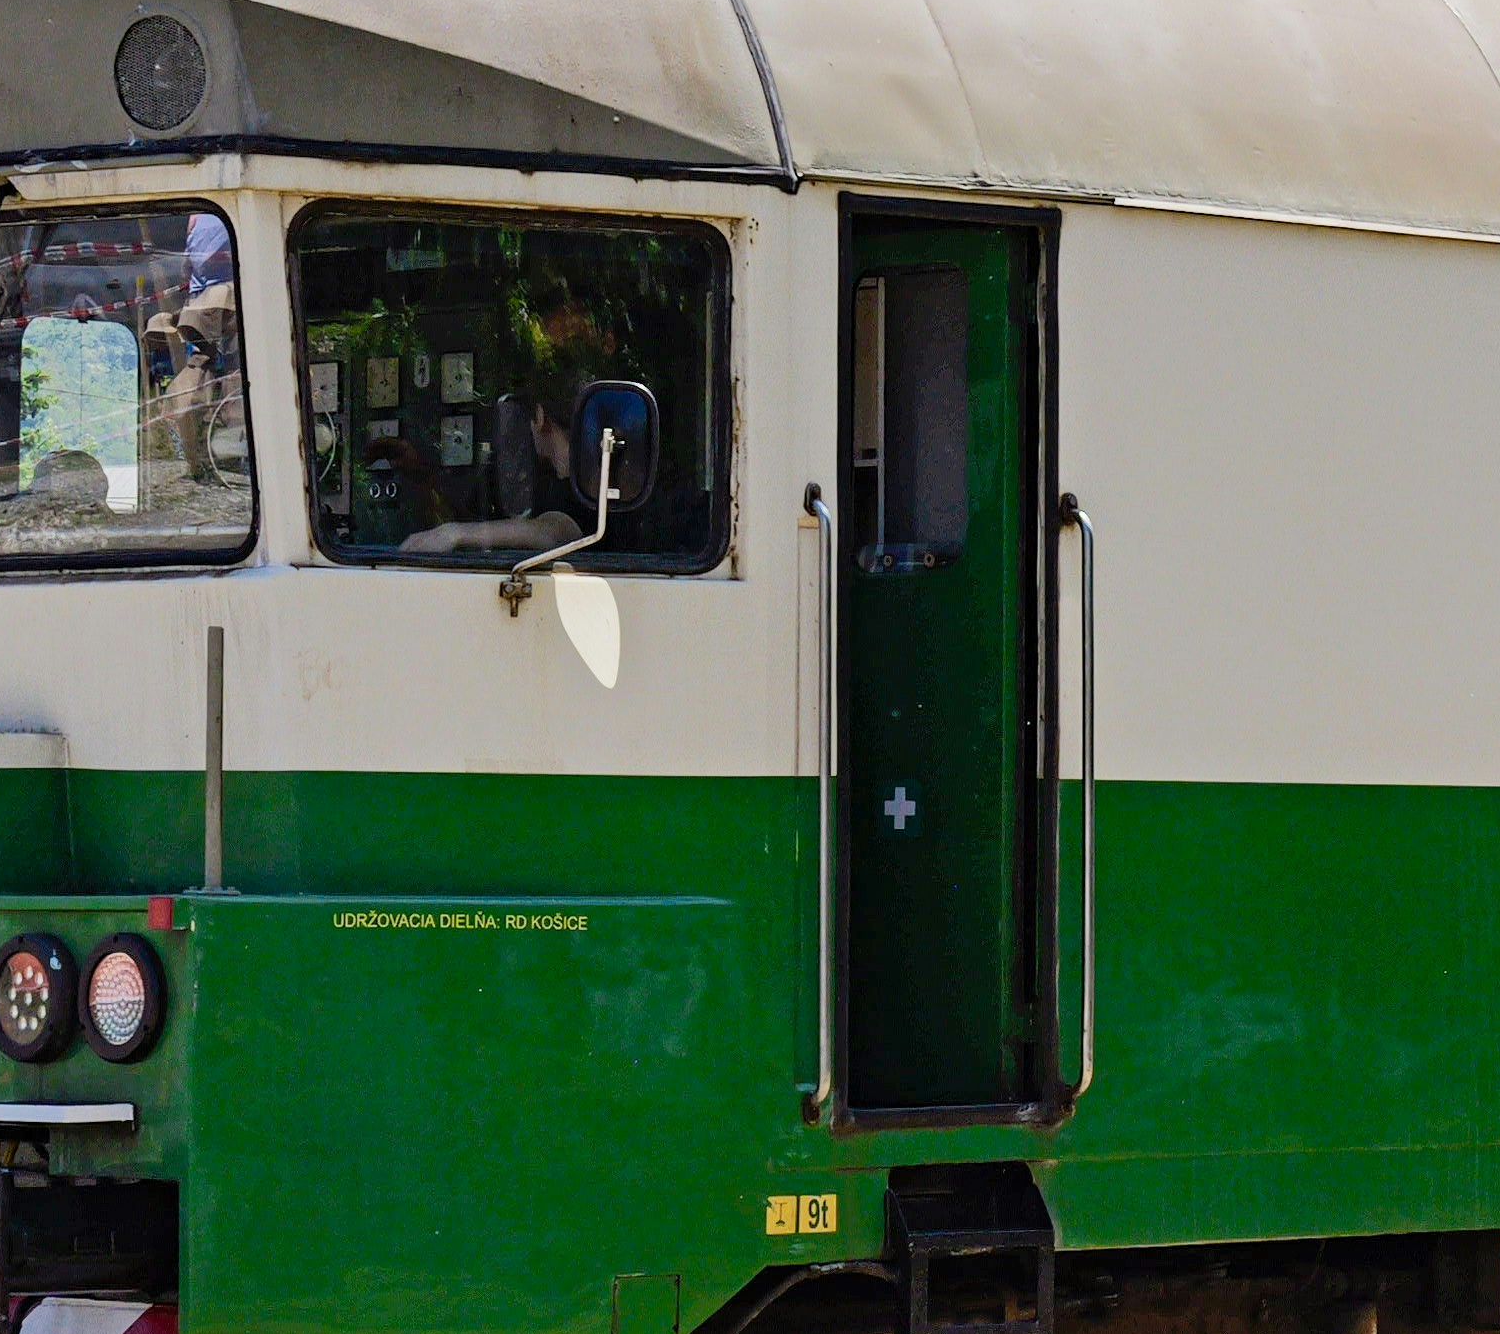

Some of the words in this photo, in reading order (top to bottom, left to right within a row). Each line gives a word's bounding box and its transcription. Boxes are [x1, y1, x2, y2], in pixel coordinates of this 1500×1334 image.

[333, 909, 436, 929] UDRŽOVACIA
[439, 910, 501, 930] DIELŇA:
[505, 914, 528, 930] RD
[531, 912, 588, 931] KOŠICE
[808, 1198, 829, 1229] 9t
